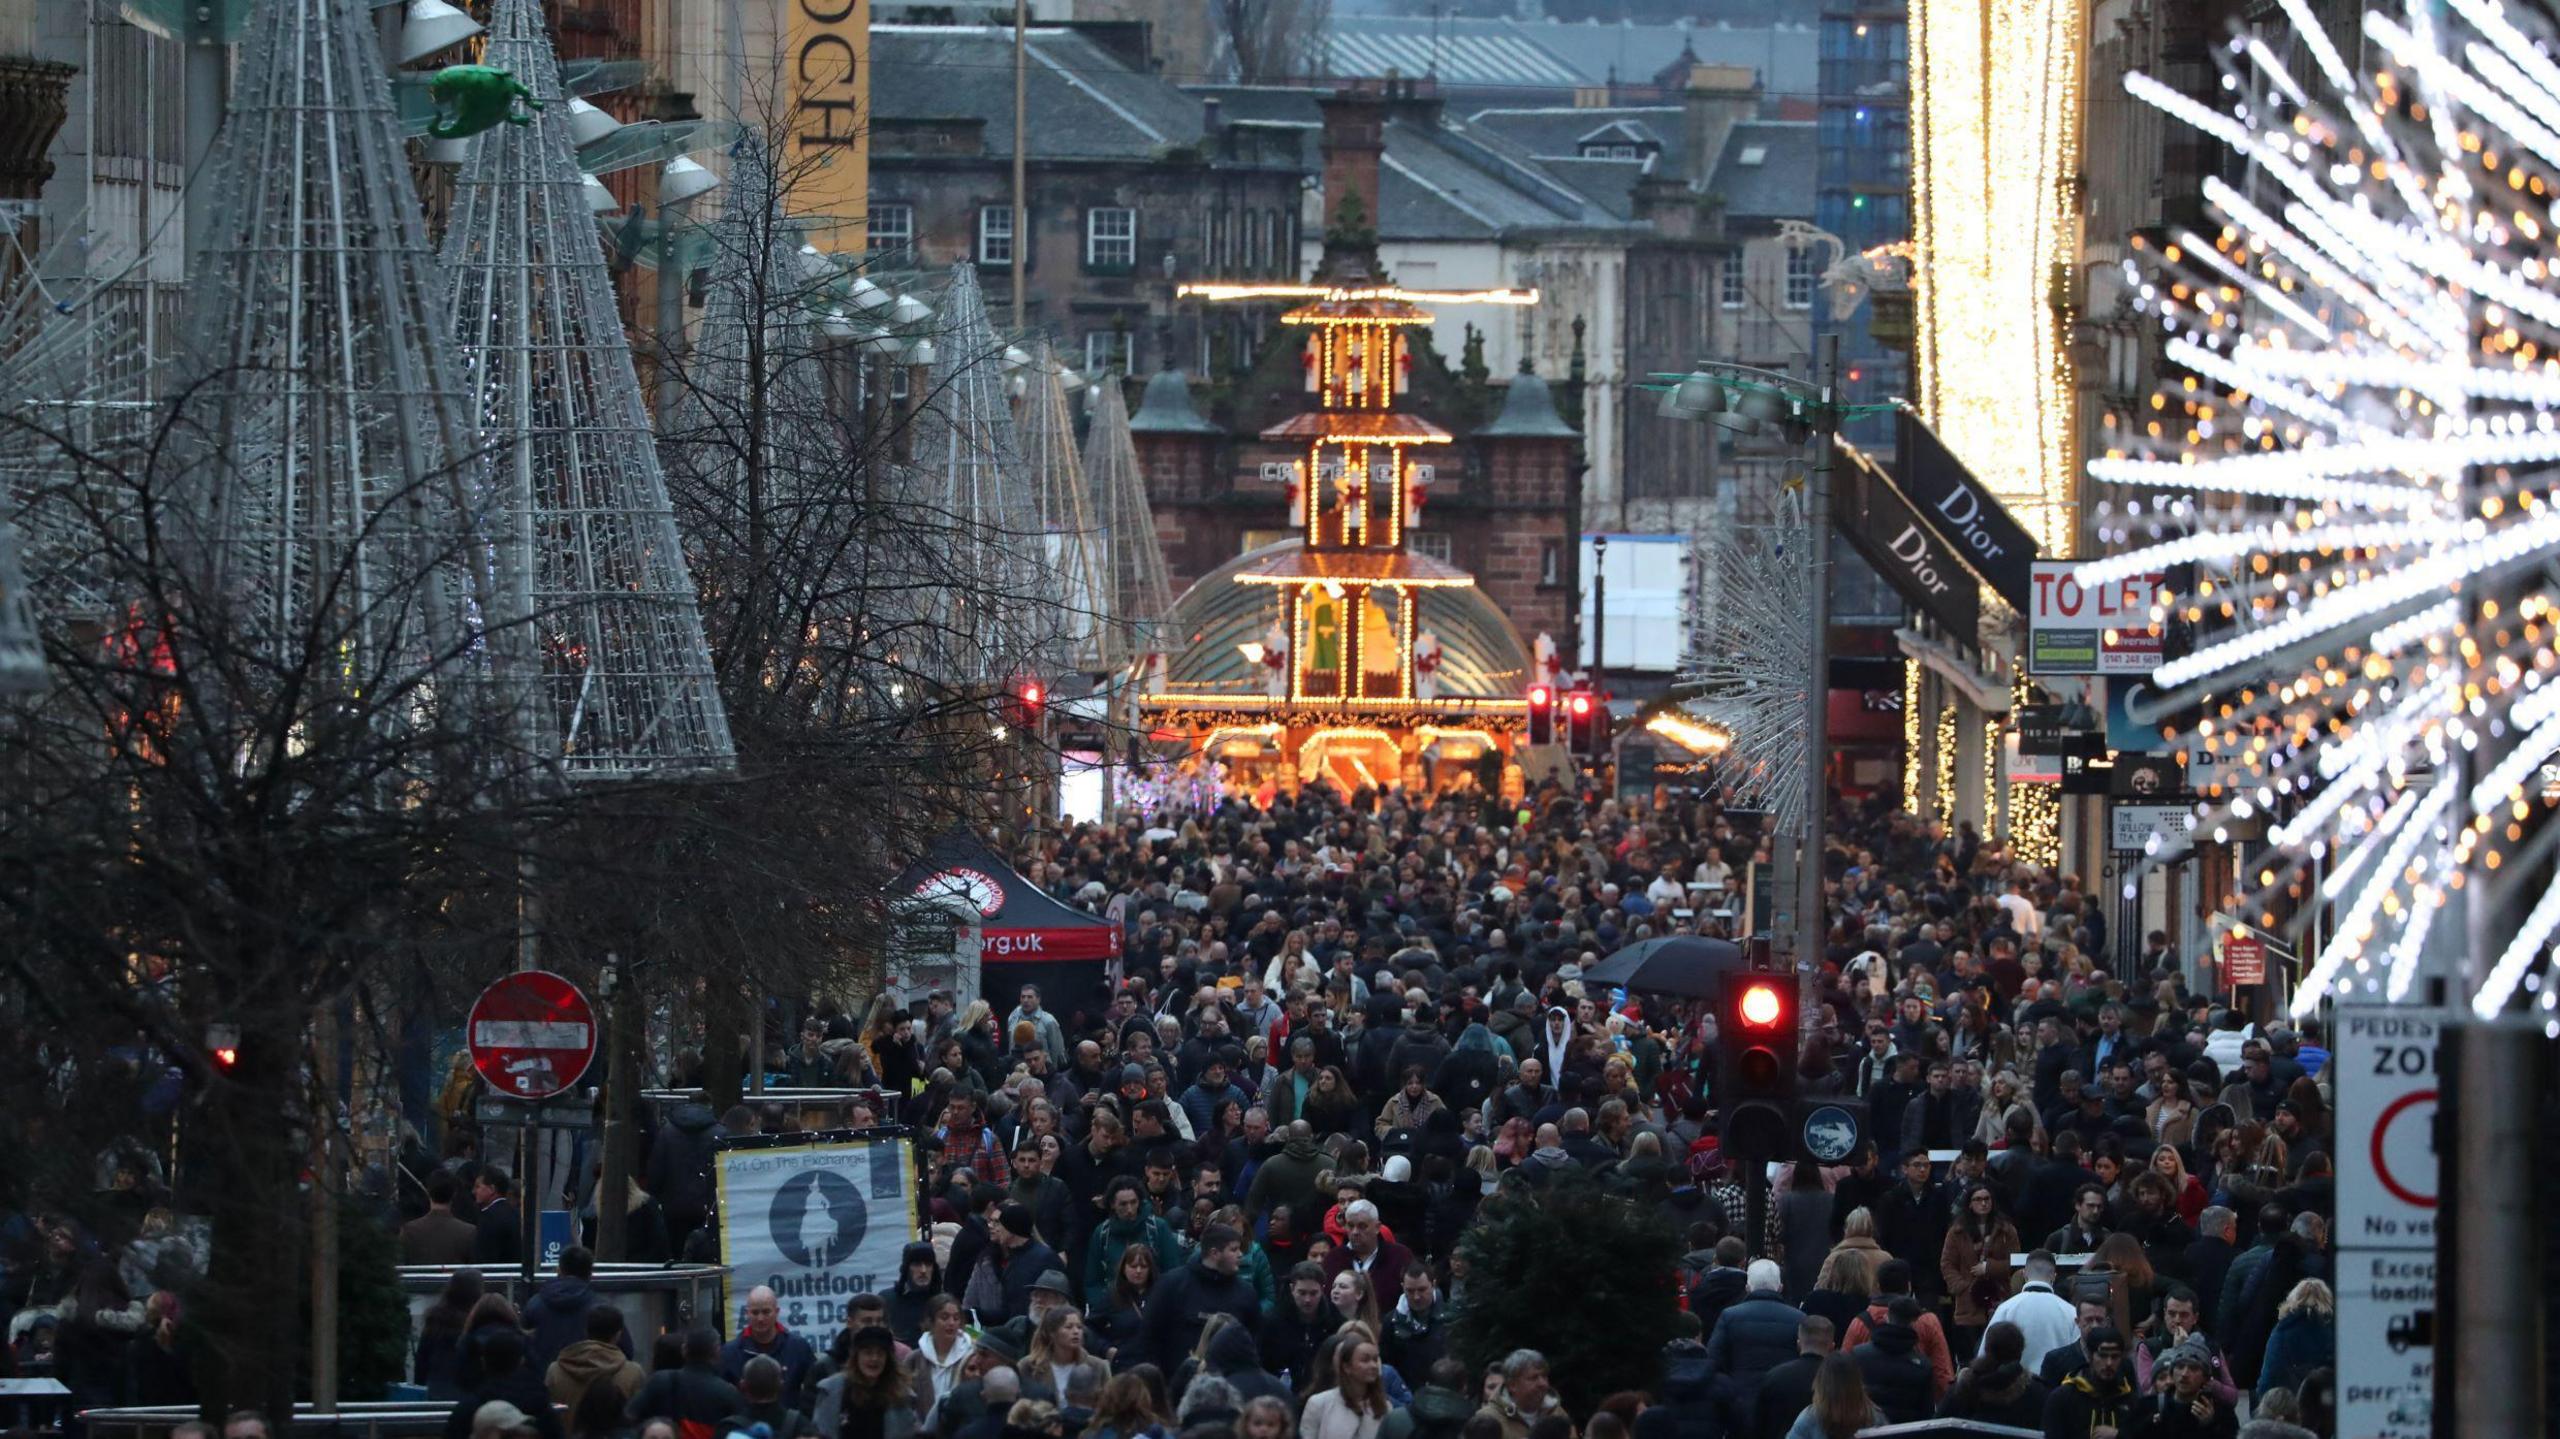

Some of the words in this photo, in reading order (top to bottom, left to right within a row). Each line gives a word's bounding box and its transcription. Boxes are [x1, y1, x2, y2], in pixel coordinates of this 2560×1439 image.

[1934, 480, 2004, 560] Dior
[1886, 521, 1949, 595] Dior
[2033, 573, 2084, 617] TO
[2098, 573, 2167, 617] LET
[2374, 1047, 2437, 1075] ZO
[728, 1160, 747, 1173] Art
[752, 1158, 770, 1172] On
[776, 1155, 800, 1169] The
[803, 1152, 867, 1168] Exchange
[2365, 1216, 2397, 1234] No
[2406, 1217, 2436, 1234] ve
[768, 1272, 877, 1298] Outdoor
[788, 1301, 808, 1327] &
